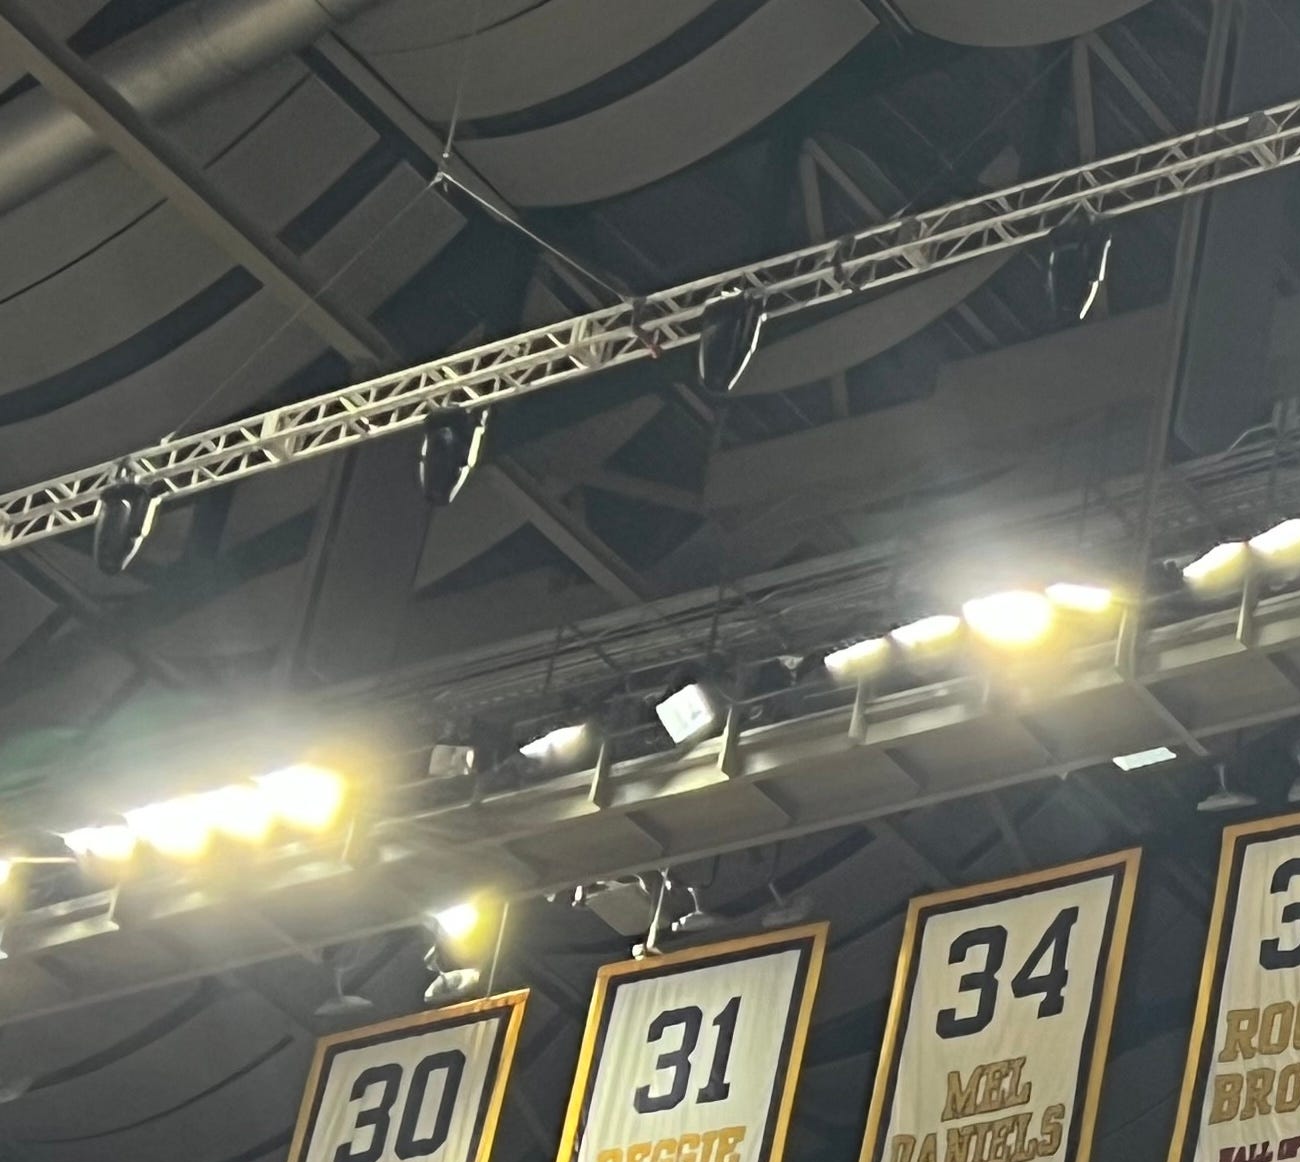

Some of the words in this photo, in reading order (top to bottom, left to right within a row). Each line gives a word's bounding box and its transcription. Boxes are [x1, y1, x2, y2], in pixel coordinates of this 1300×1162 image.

[936, 907, 1079, 1039] 34
[634, 996, 741, 1114] 31
[941, 1056, 1032, 1122] MEL
